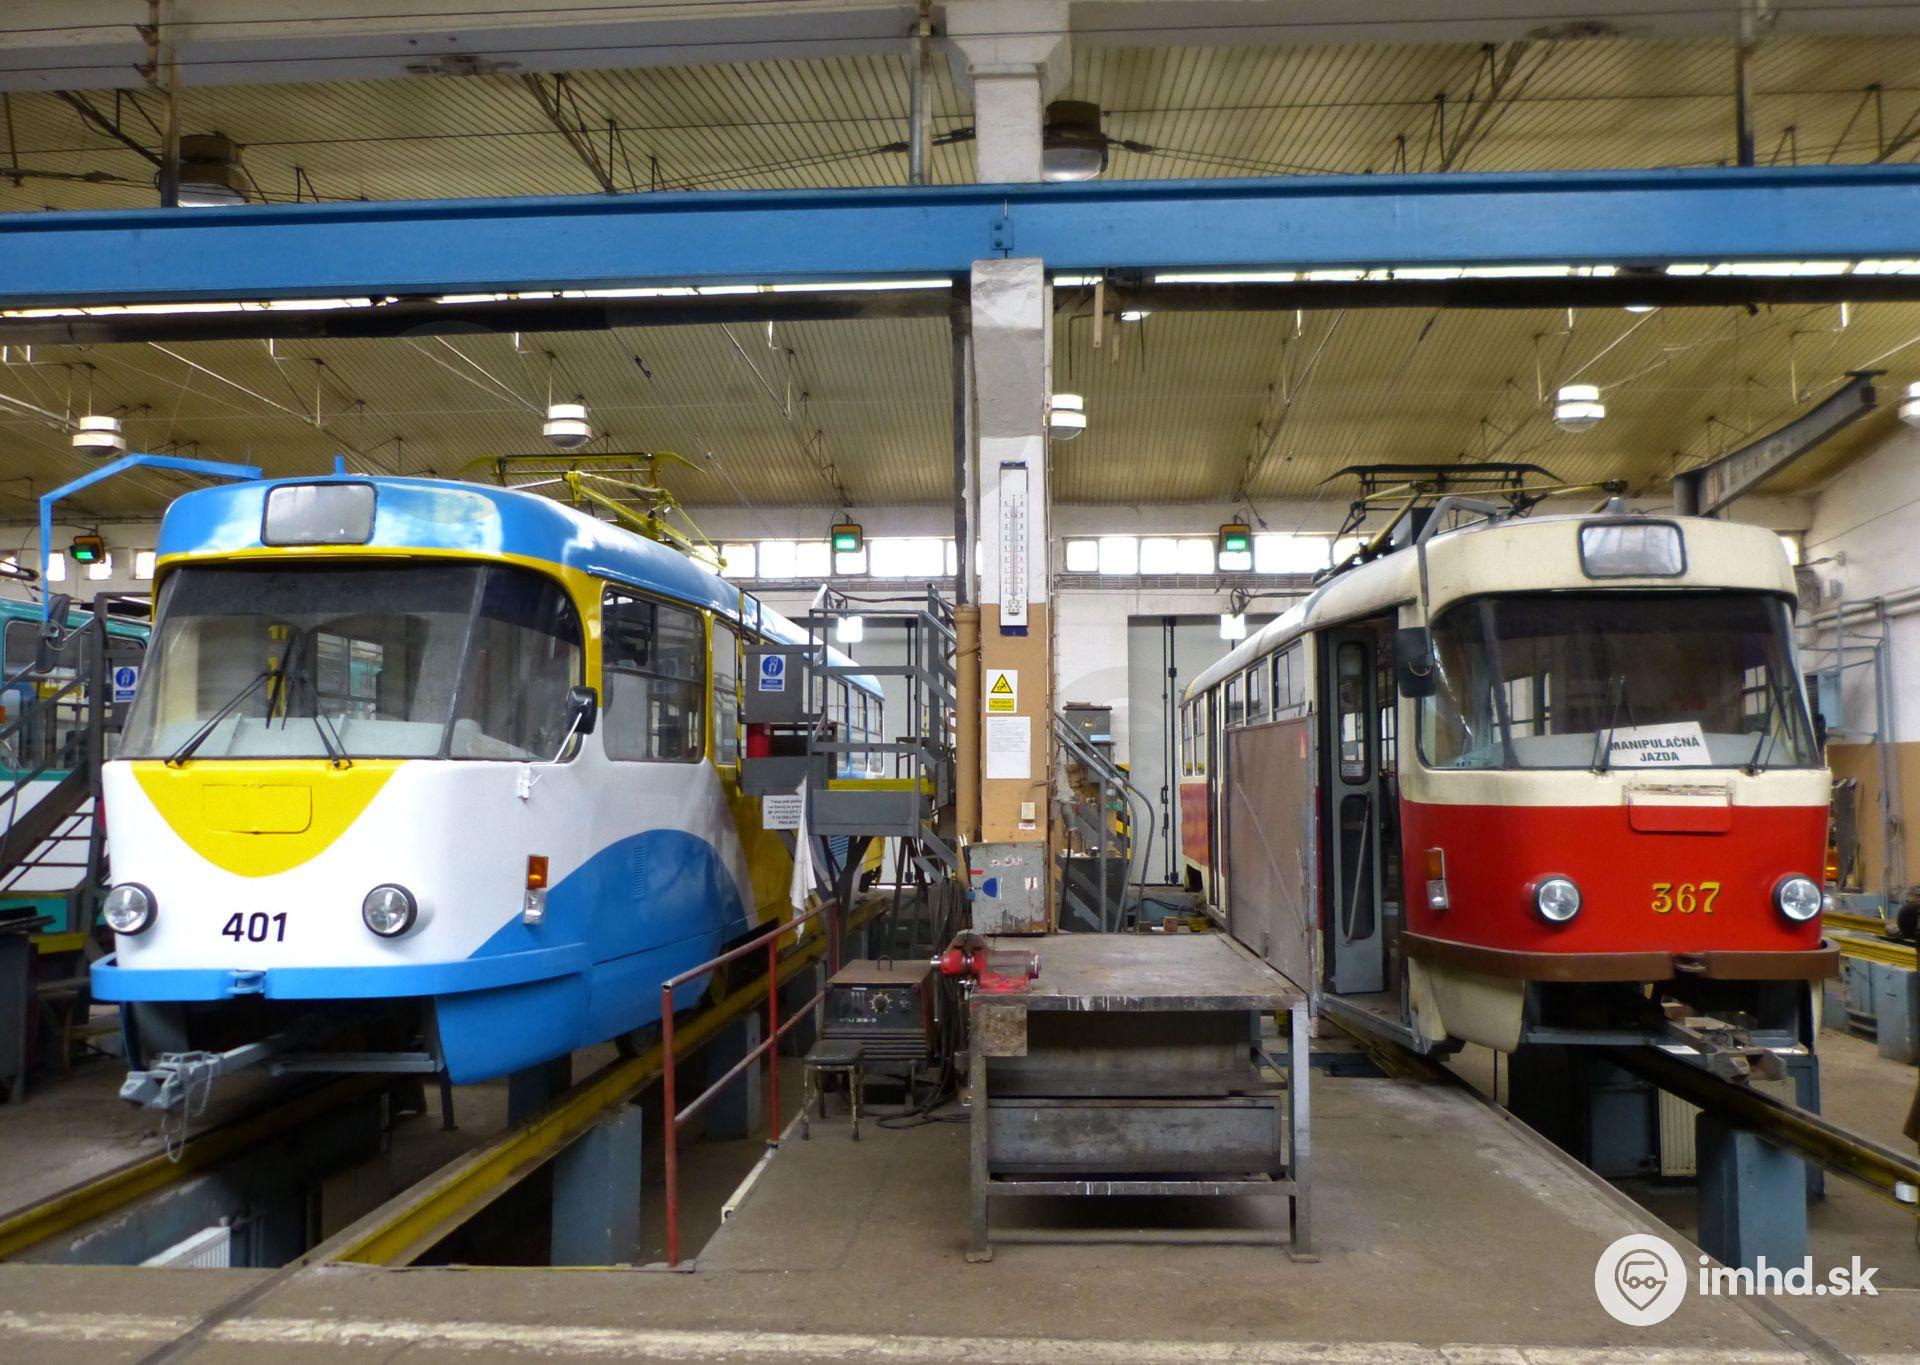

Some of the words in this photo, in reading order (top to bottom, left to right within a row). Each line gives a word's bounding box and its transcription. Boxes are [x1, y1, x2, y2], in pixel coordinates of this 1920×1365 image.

[1610, 735, 1700, 751] MANIPULAČNÁ
[1640, 752, 1680, 762] JAZDA
[1651, 882, 1721, 914] 367
[222, 912, 287, 942] 401
